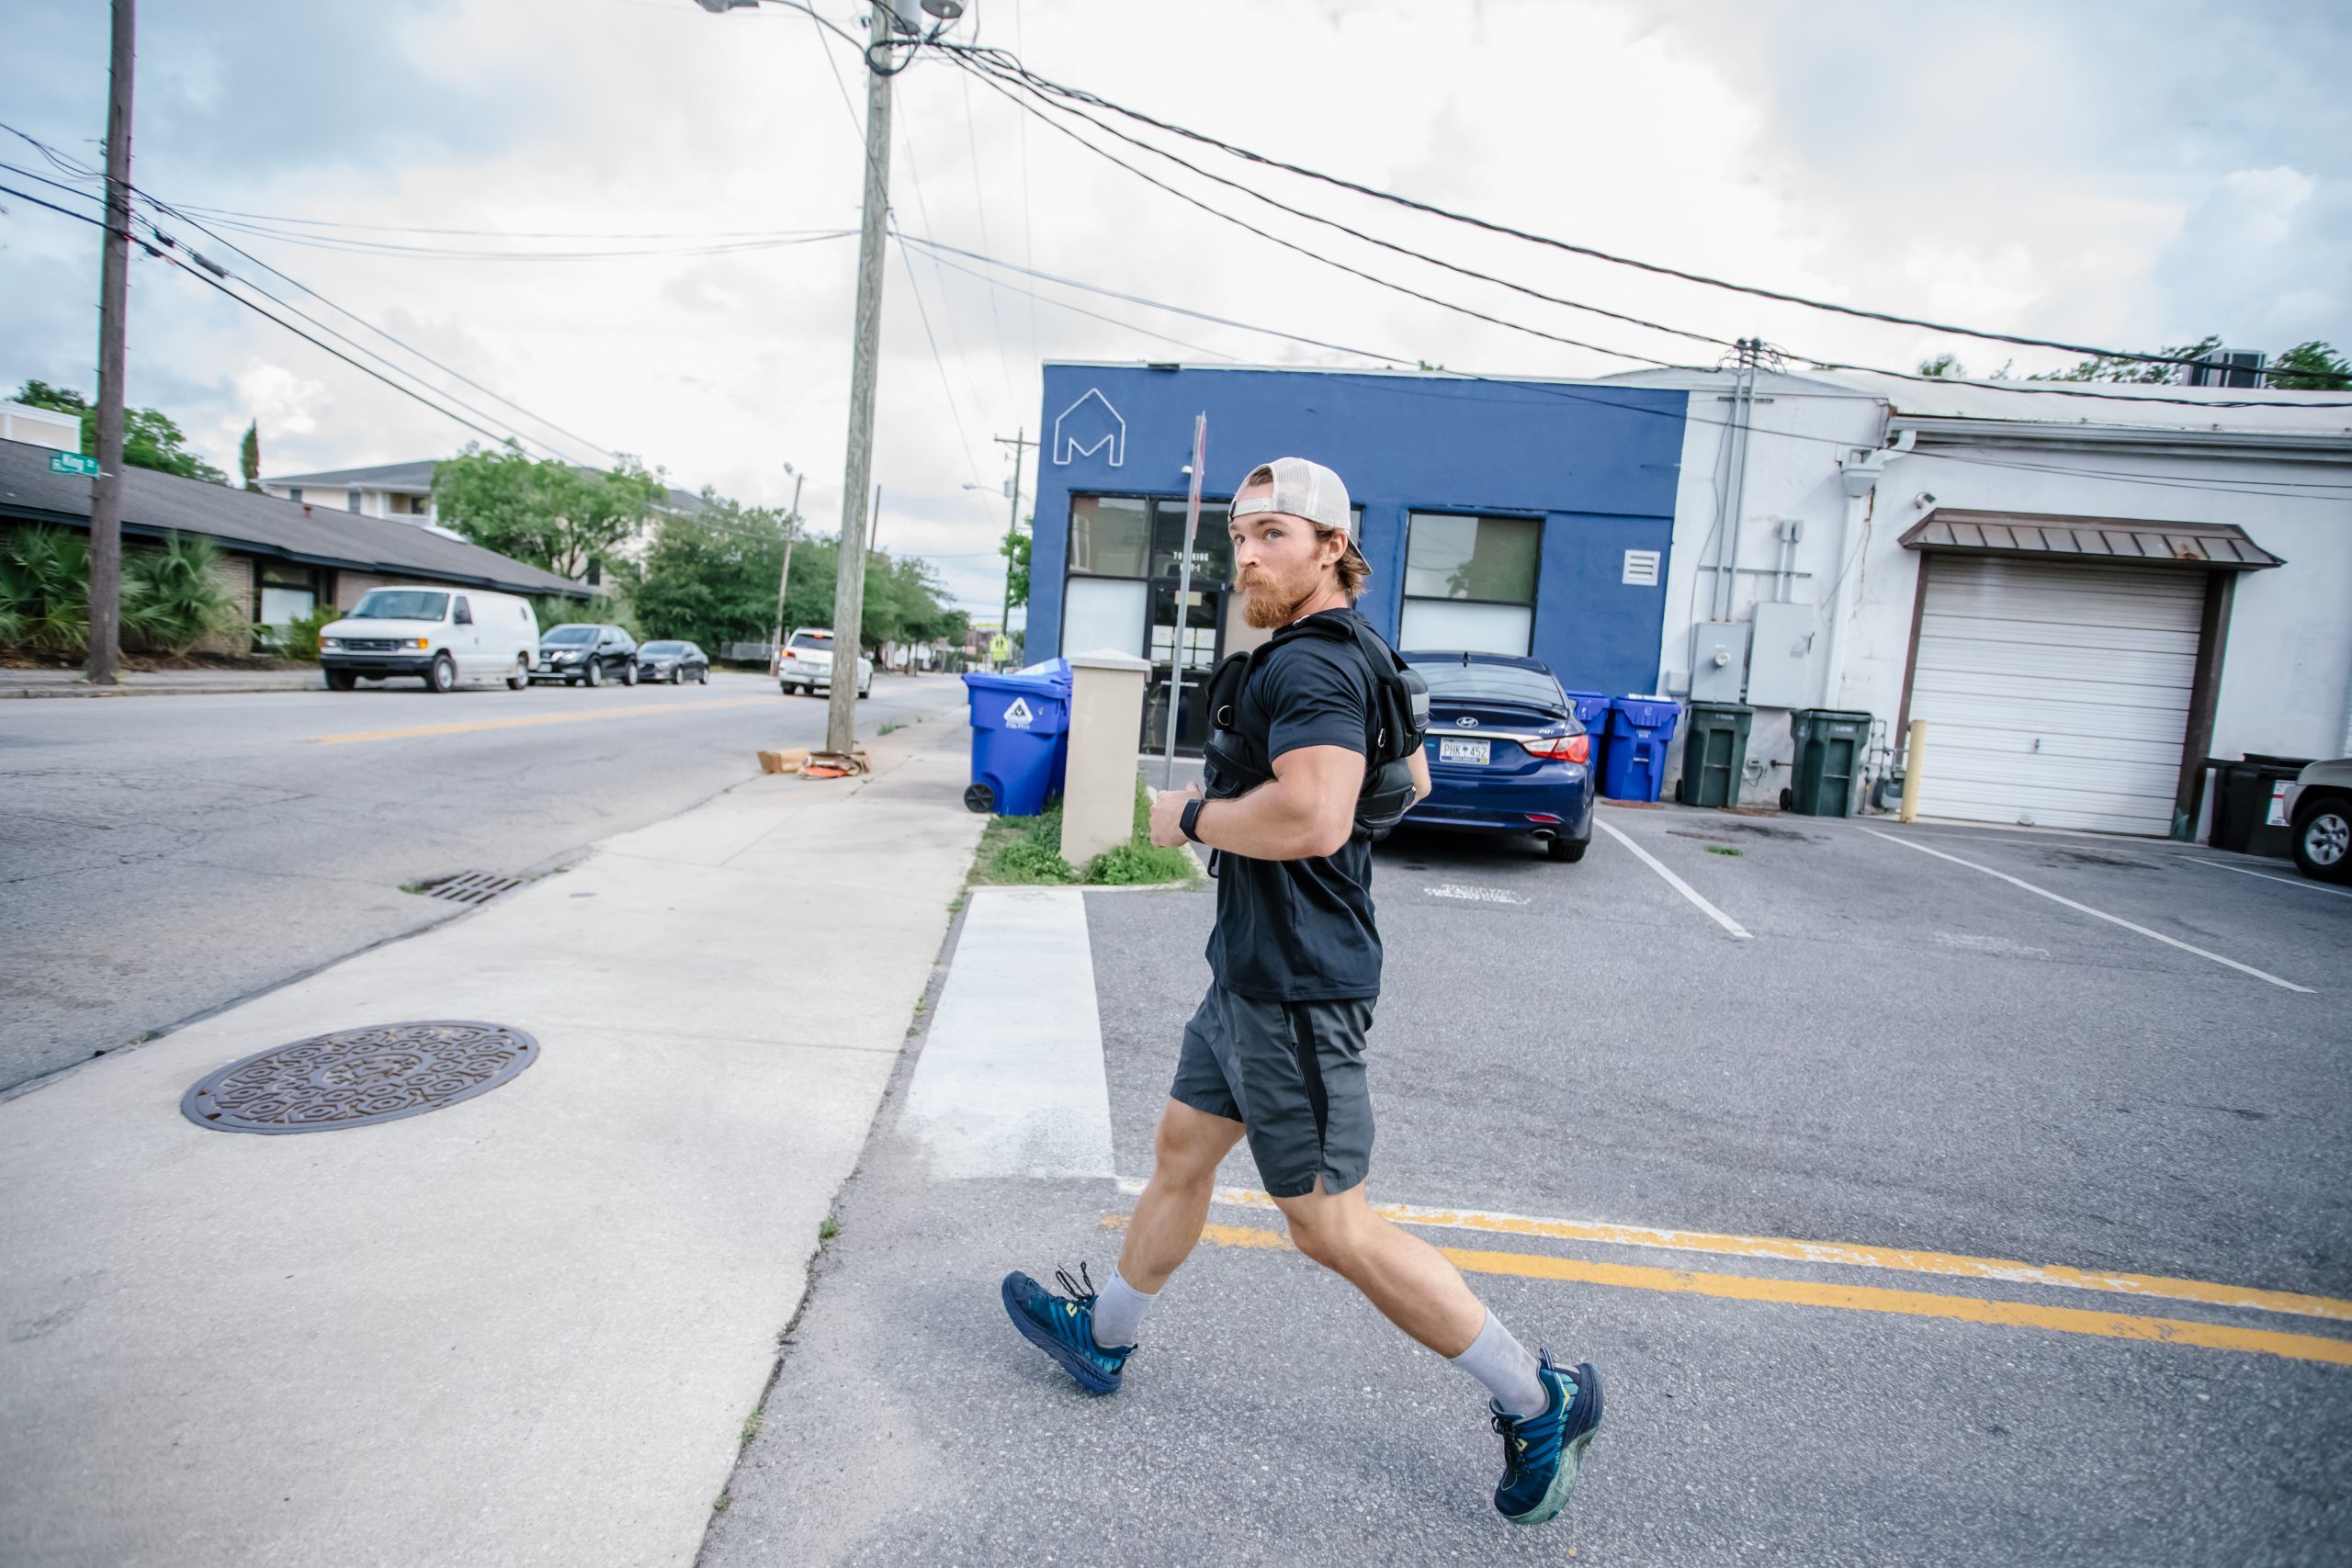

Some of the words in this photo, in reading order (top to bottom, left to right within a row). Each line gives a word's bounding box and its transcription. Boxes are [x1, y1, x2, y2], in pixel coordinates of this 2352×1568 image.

[62, 453, 85, 472] King
[1192, 552, 1209, 562] KING
[1158, 631, 1210, 642] mason
[1443, 744, 1462, 756] PHK
[1470, 745, 1487, 758] 452
